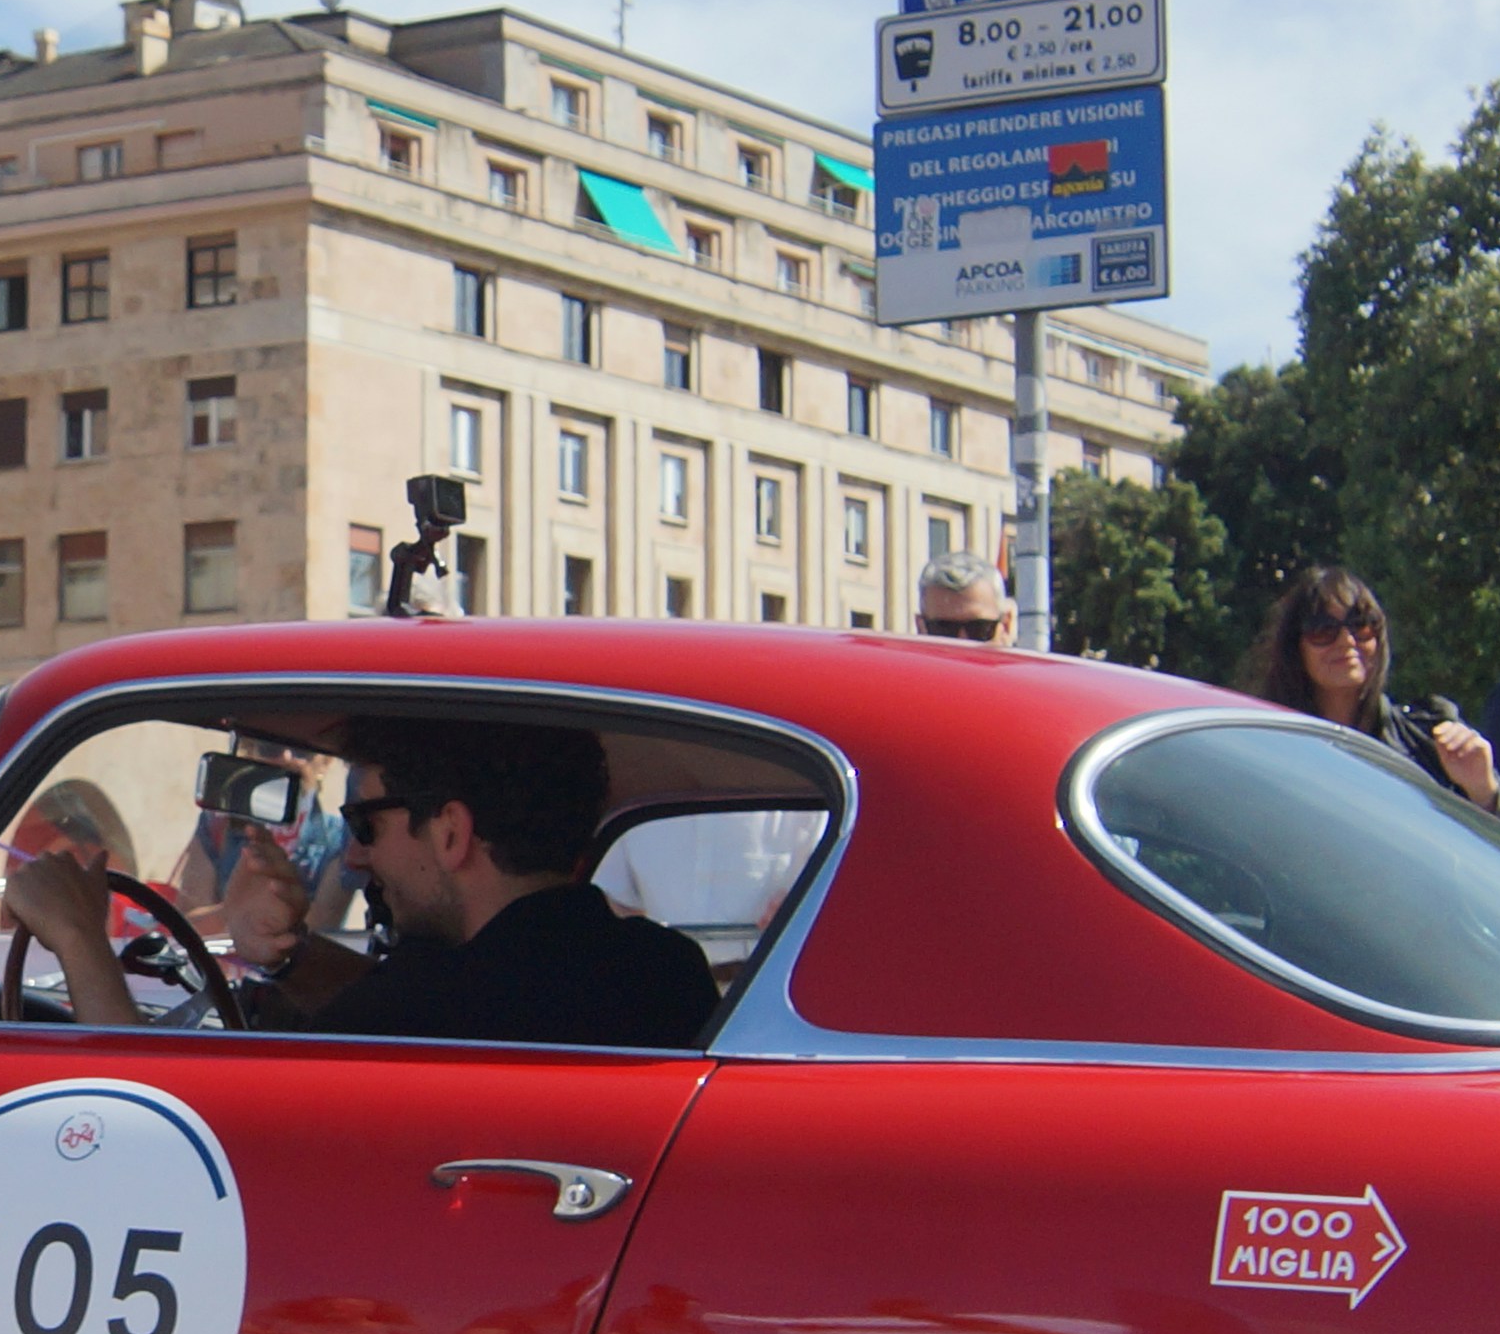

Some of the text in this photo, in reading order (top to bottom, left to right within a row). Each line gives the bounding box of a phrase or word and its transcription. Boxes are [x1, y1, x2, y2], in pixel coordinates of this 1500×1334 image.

[958, 20, 1021, 46] 8.00
[1064, 3, 1144, 32] 21.00
[963, 71, 1014, 90] tariffa
[1022, 64, 1077, 83] minima
[881, 98, 1146, 149] PREGASI PRENDERE VISIONE
[909, 160, 945, 179] DEL
[1110, 169, 1137, 188] SU
[1032, 201, 1152, 231] ARCOMETRO
[956, 260, 1024, 283] APCOA
[1243, 1206, 1354, 1240] 1000
[1228, 1244, 1356, 1282] MIGLIA
